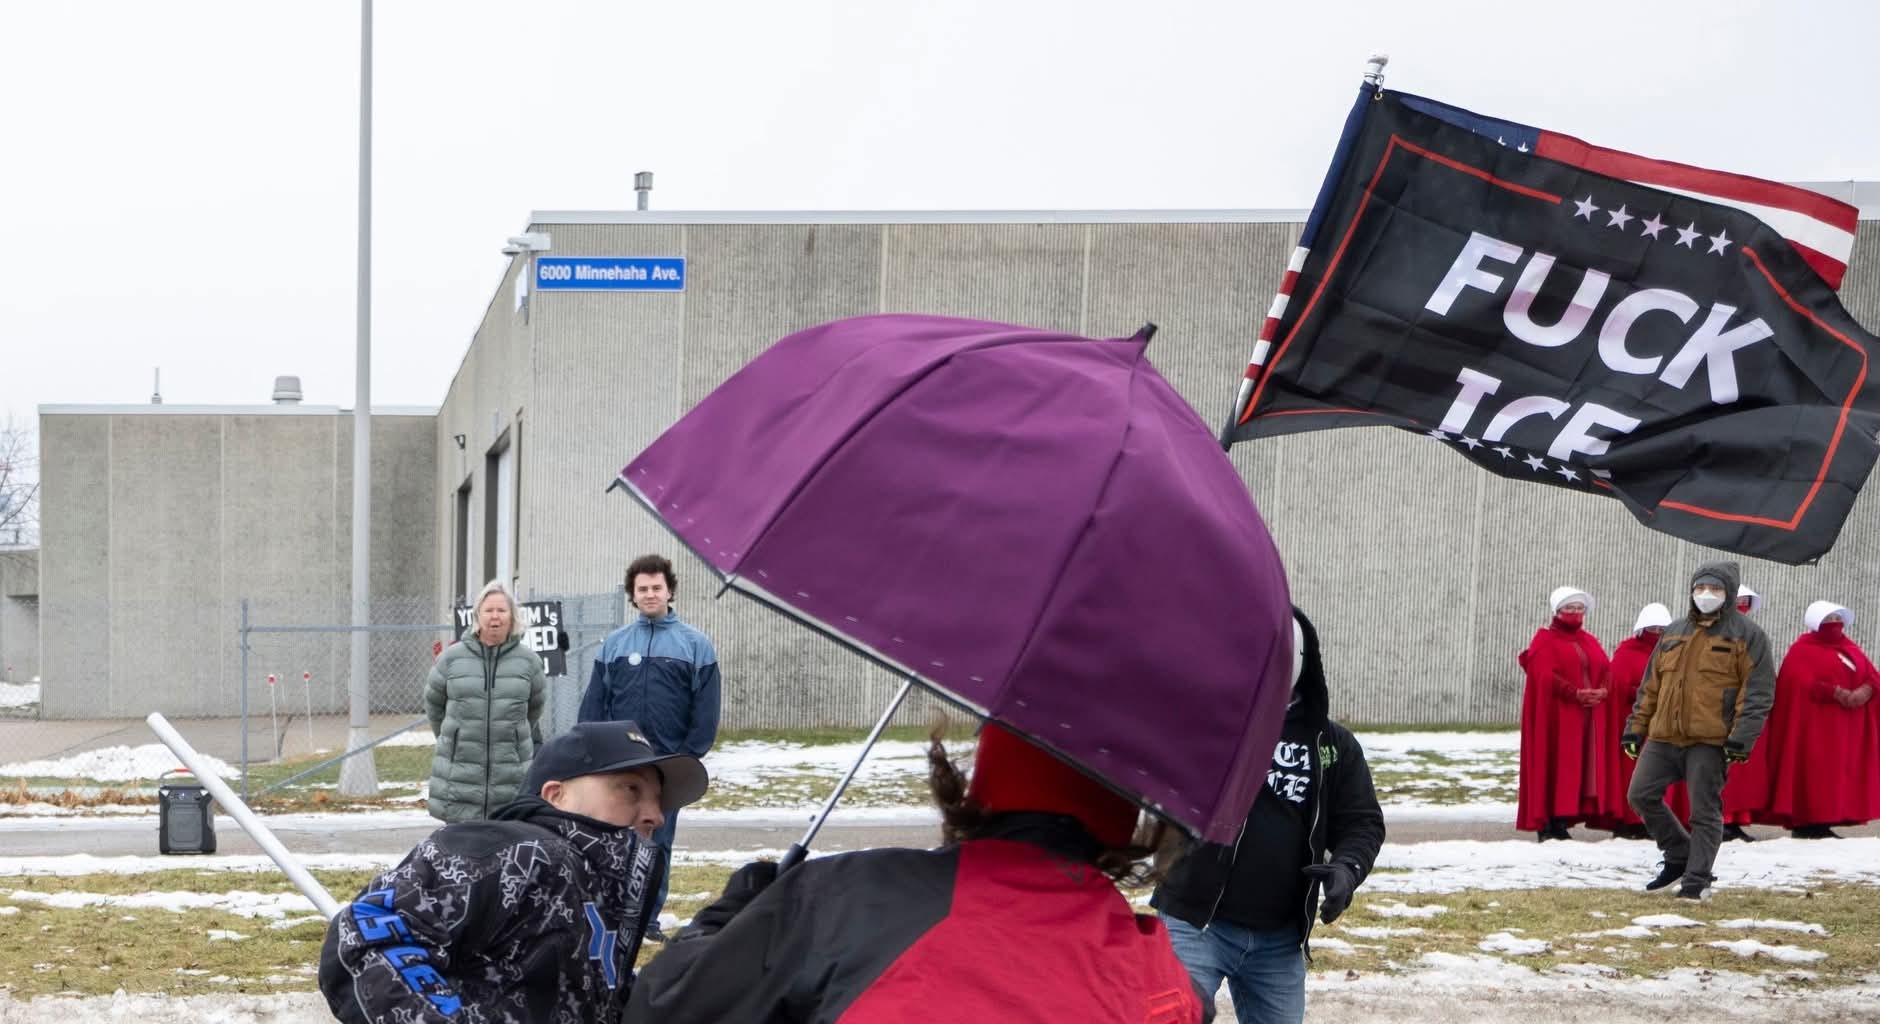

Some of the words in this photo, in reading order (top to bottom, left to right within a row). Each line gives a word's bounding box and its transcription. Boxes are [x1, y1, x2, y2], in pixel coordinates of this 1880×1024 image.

[540, 265, 571, 280] 6000
[575, 265, 647, 280] Minnehaha
[652, 266, 680, 280] Ave.
[1425, 231, 1774, 405] FUCK
